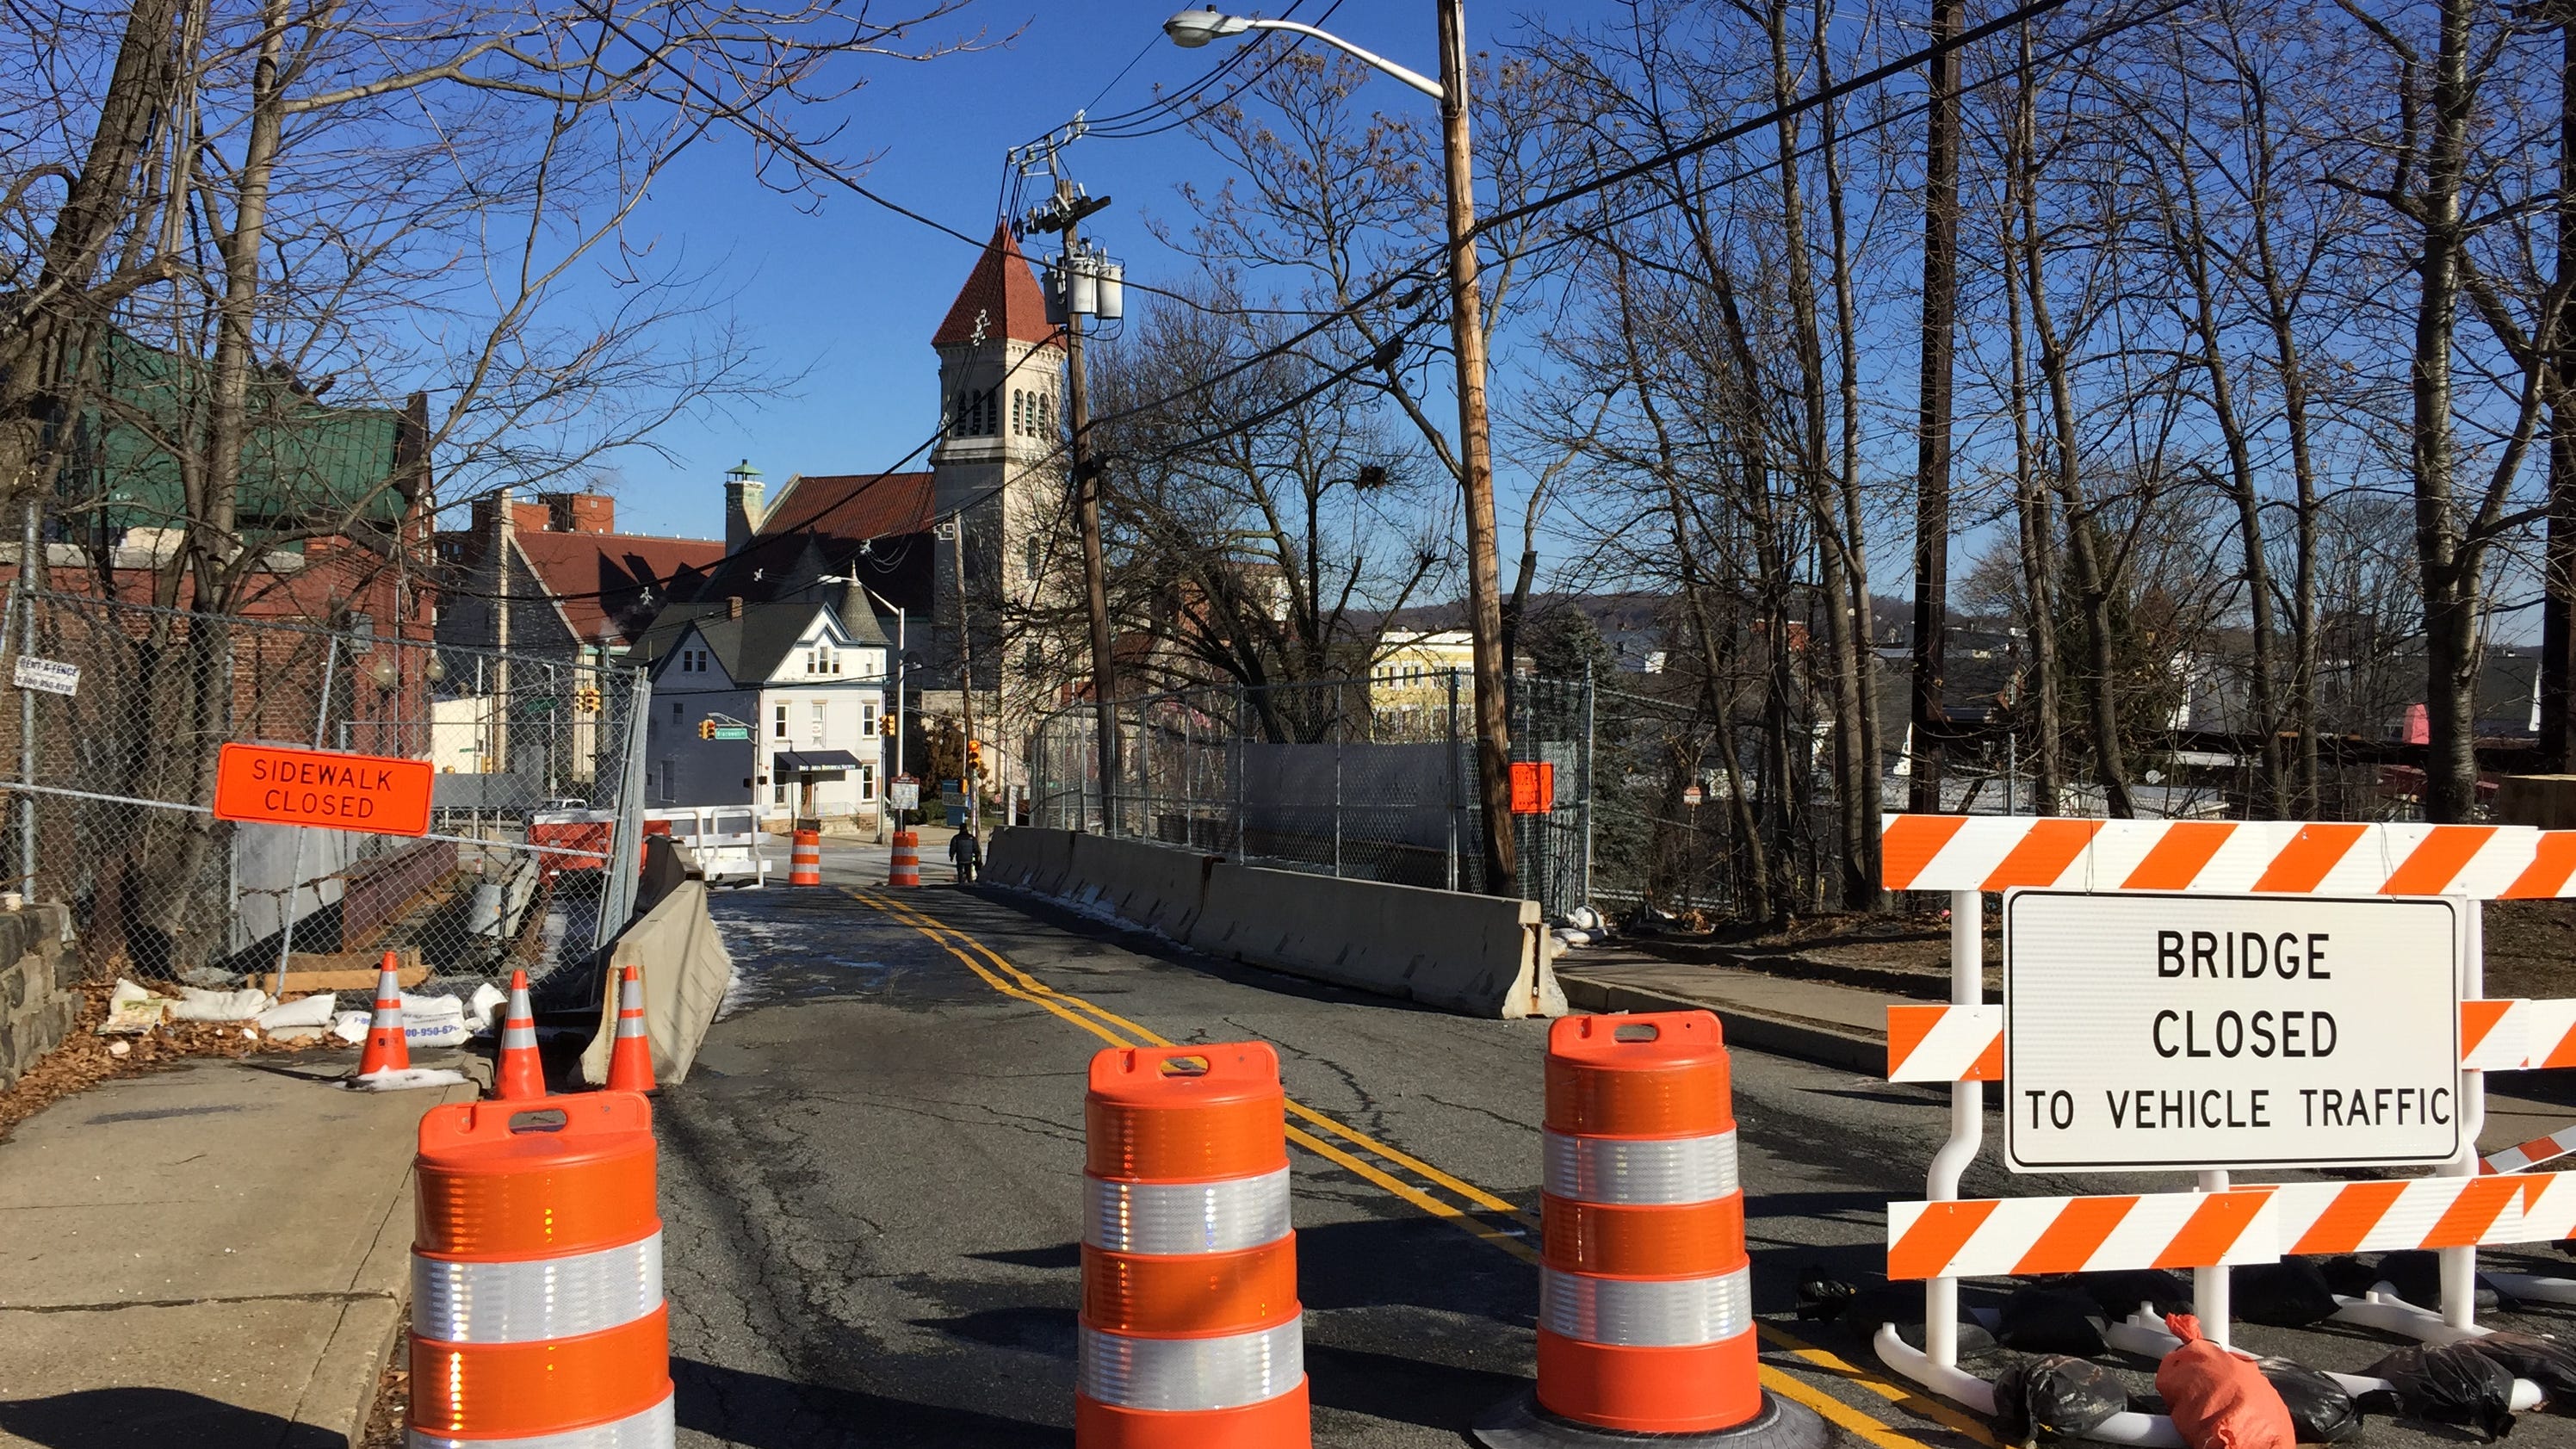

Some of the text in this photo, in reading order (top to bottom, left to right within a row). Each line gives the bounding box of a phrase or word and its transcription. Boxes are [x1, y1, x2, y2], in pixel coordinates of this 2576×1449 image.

[252, 758, 393, 791] SIDEWALK
[264, 790, 374, 818] CLOSED
[2158, 930, 2331, 981] BRIDGE
[2152, 1009, 2338, 1059] CLOSED
[2025, 1087, 2450, 1130] TO VEHICLE TRAFFIC
